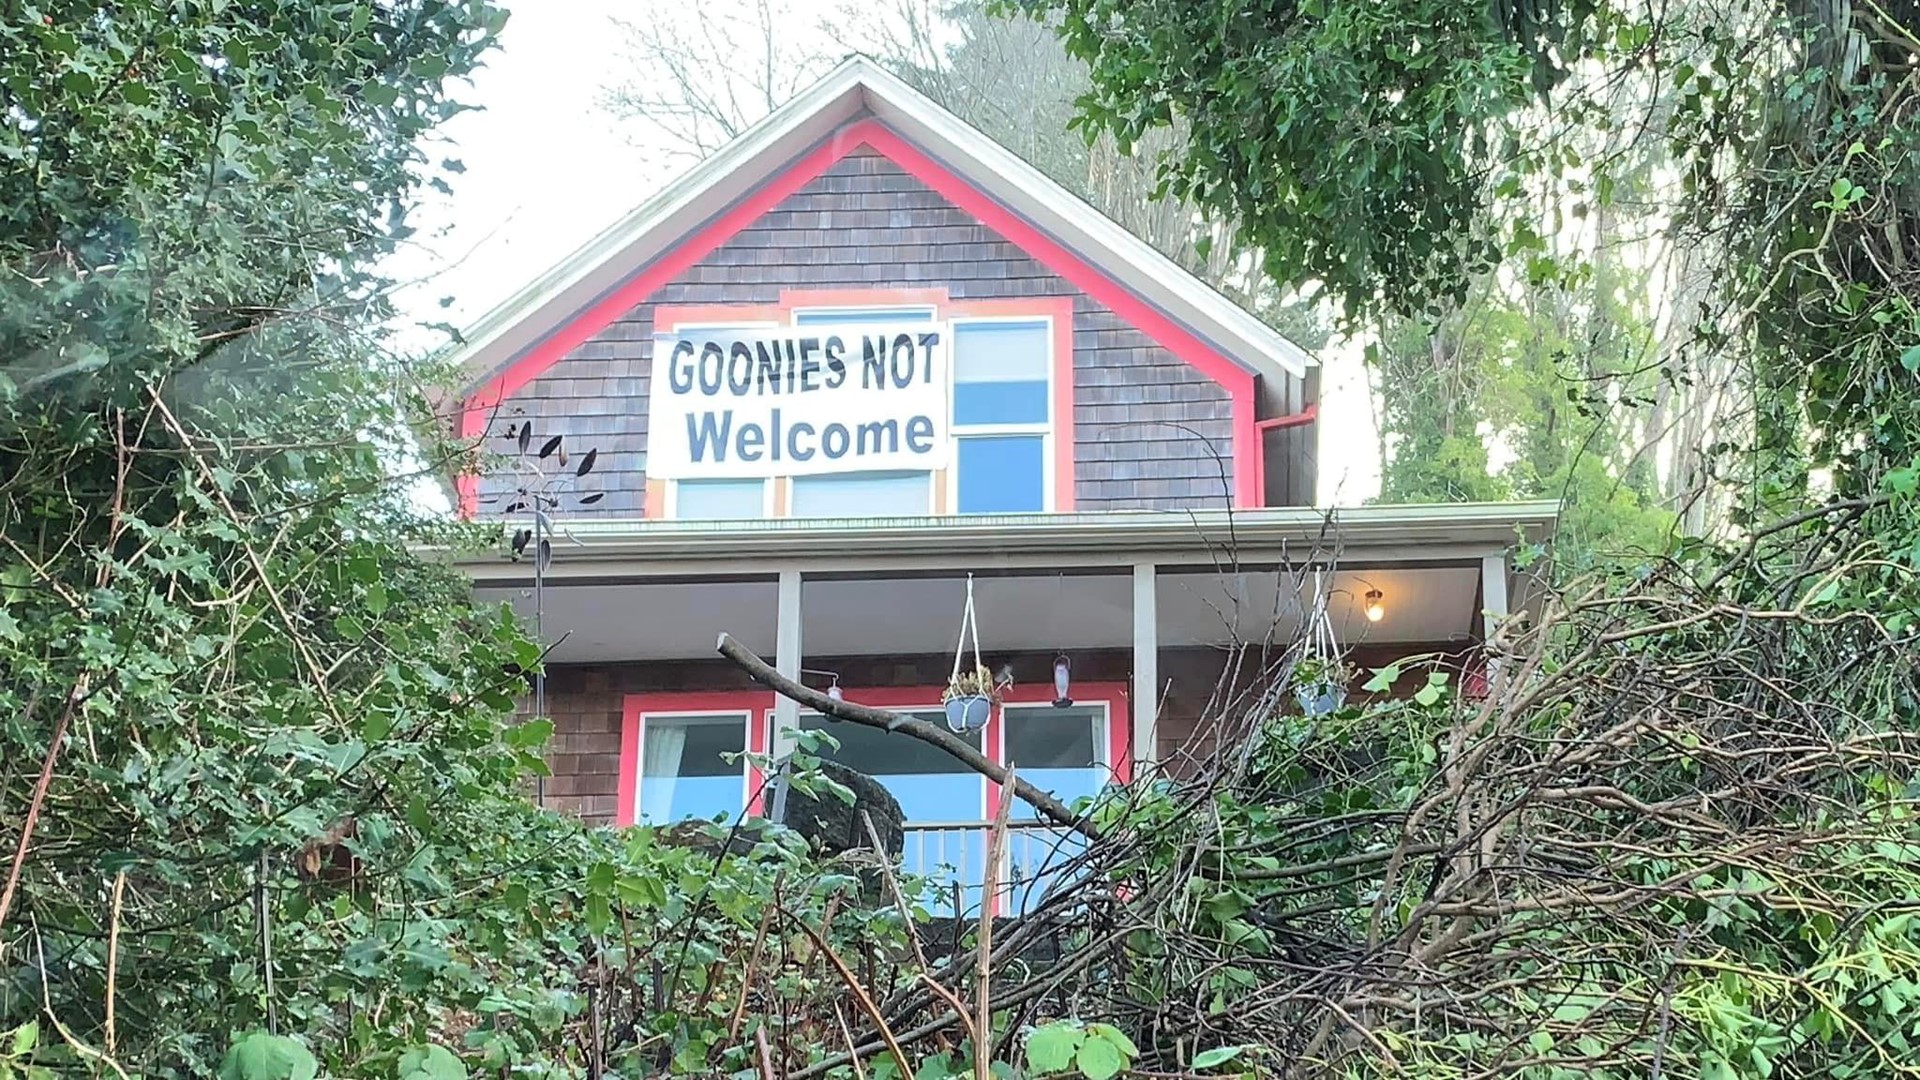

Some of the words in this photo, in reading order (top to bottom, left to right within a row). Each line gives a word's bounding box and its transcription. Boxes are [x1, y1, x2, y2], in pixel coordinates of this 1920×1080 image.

[669, 336, 846, 396] GOONIES
[862, 333, 939, 390] NOT
[686, 408, 934, 463] Welcome
